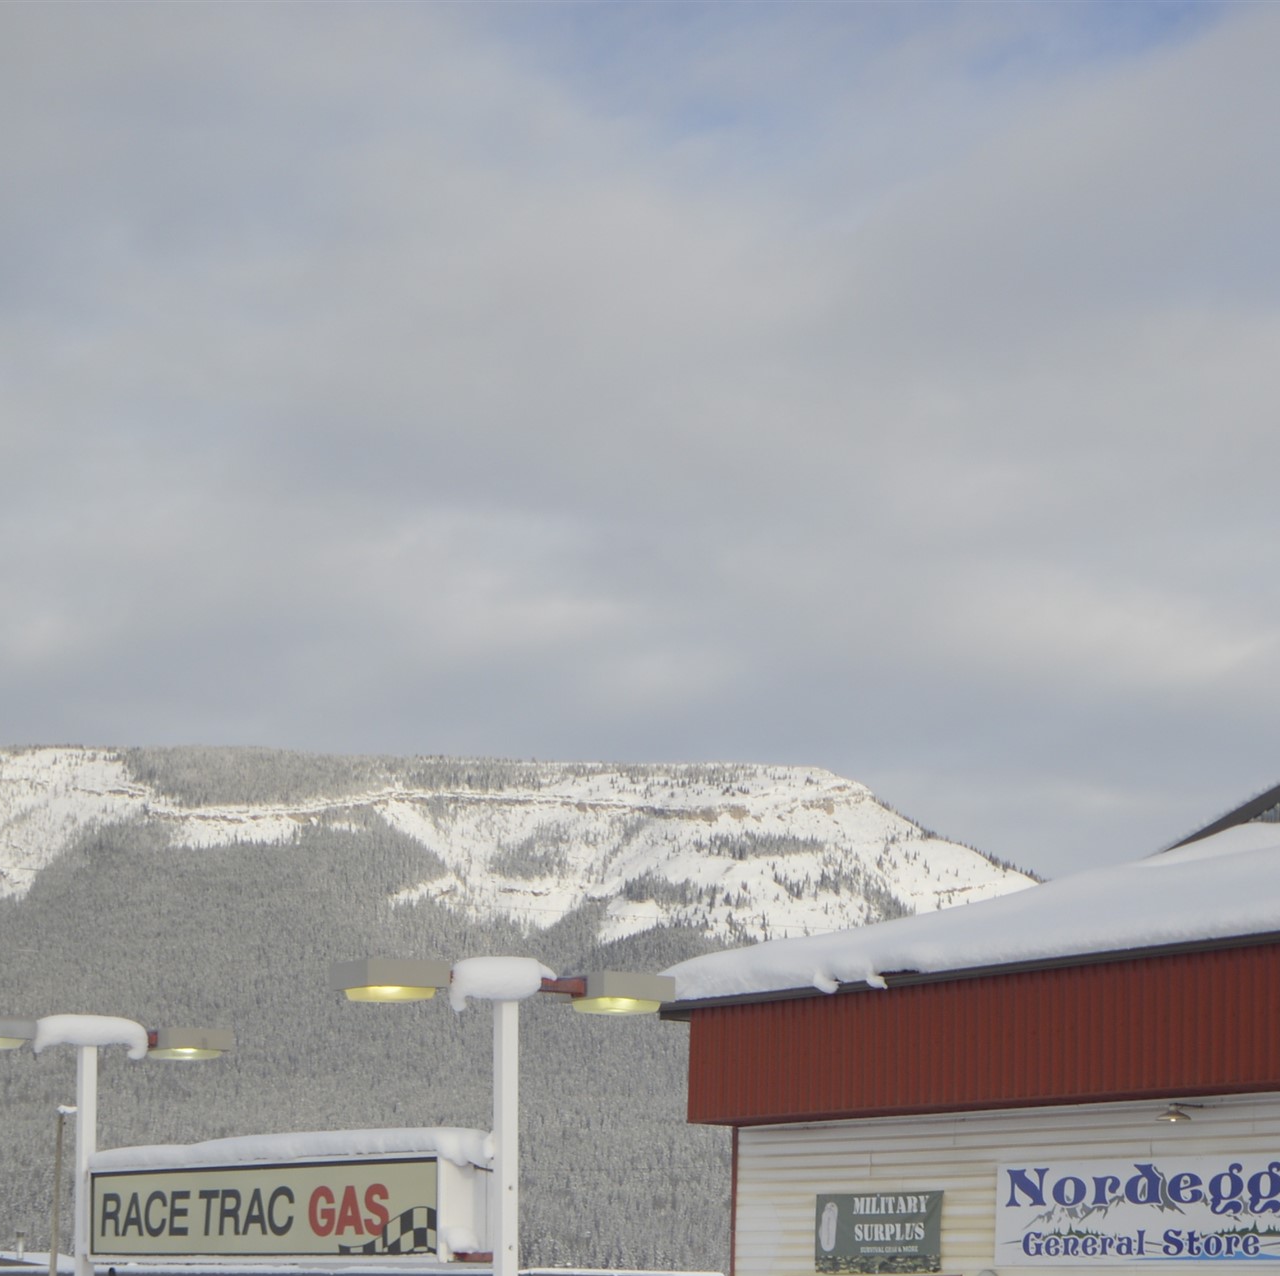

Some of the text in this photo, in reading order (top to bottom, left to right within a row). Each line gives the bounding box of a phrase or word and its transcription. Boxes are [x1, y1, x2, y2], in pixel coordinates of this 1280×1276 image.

[101, 1183, 390, 1237] RACE TRAC GAS
[852, 1194, 930, 1214] MILITARY
[854, 1222, 926, 1242] SURPLUS
[1021, 1229, 1261, 1257] General Store
